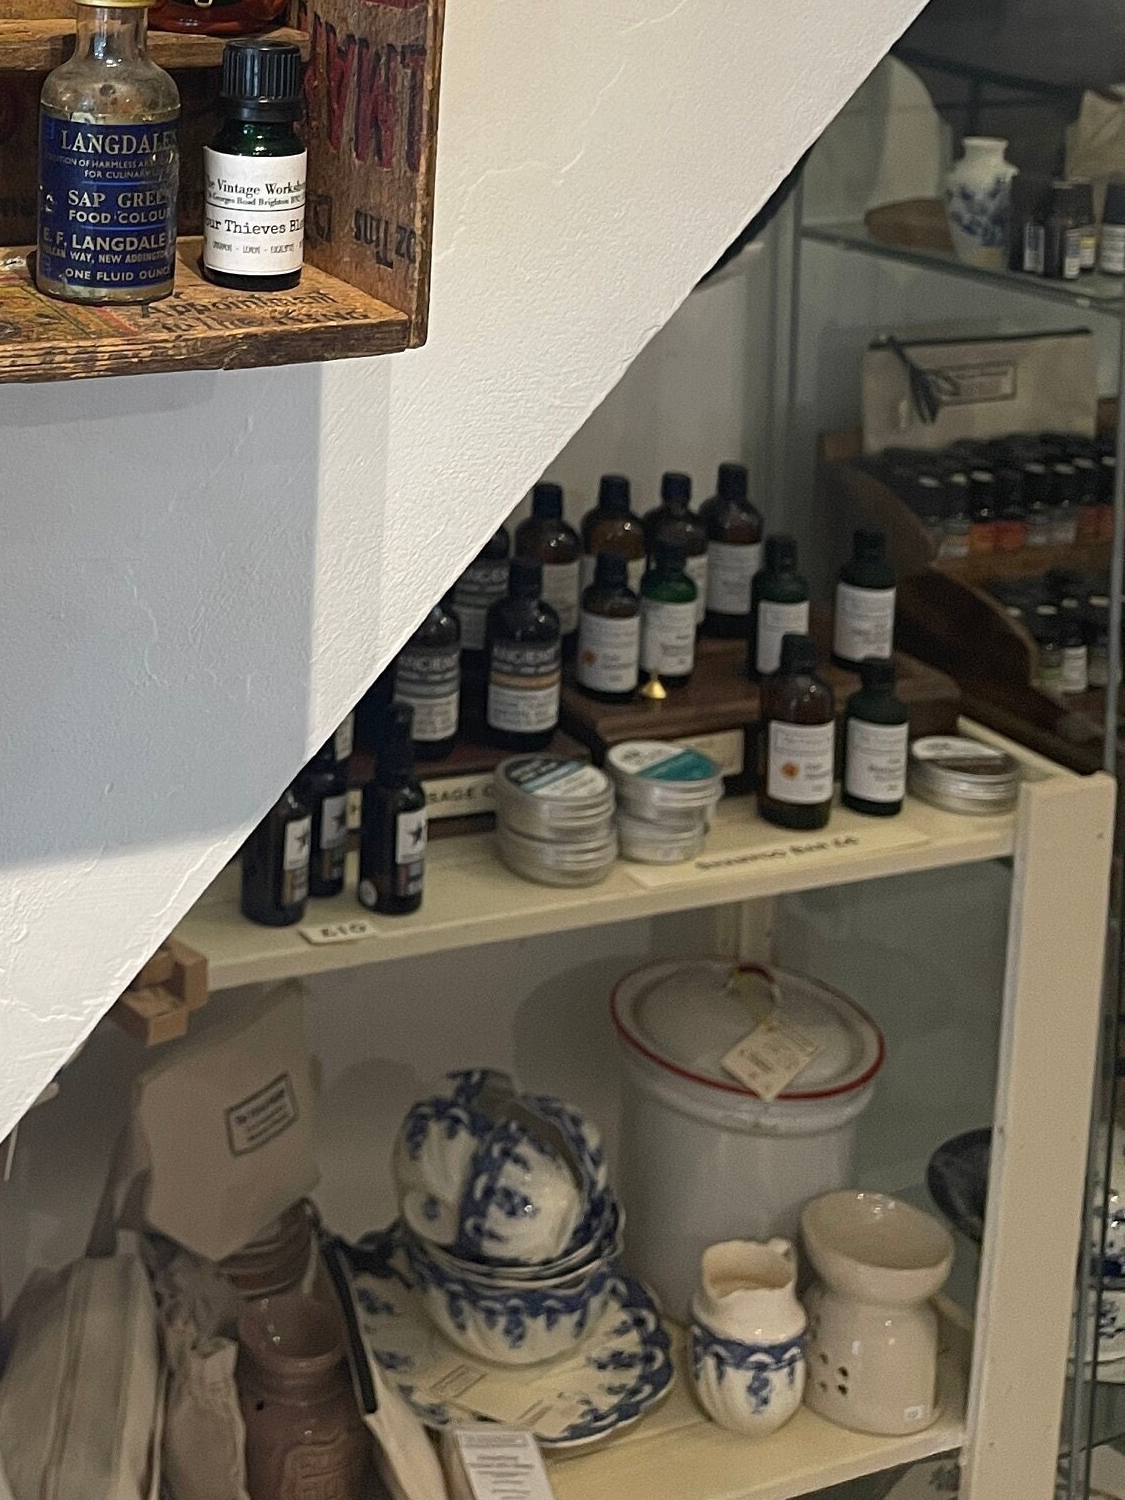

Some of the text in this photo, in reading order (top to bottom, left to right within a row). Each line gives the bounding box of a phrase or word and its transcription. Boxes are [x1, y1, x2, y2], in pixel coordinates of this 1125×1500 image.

[91, 159, 137, 169] HARMLESS
[84, 169, 103, 179] FOR
[217, 178, 261, 199] Vintage
[68, 189, 169, 209] SAP GREE
[237, 197, 256, 206] Road
[68, 209, 111, 224] FOOD
[225, 219, 286, 235] Thieves
[72, 233, 166, 251] LANGDALE
[70, 251, 95, 264] WAY,
[98, 254, 122, 264] NEW
[65, 267, 92, 281] ONE
[96, 269, 134, 282] FLUID
